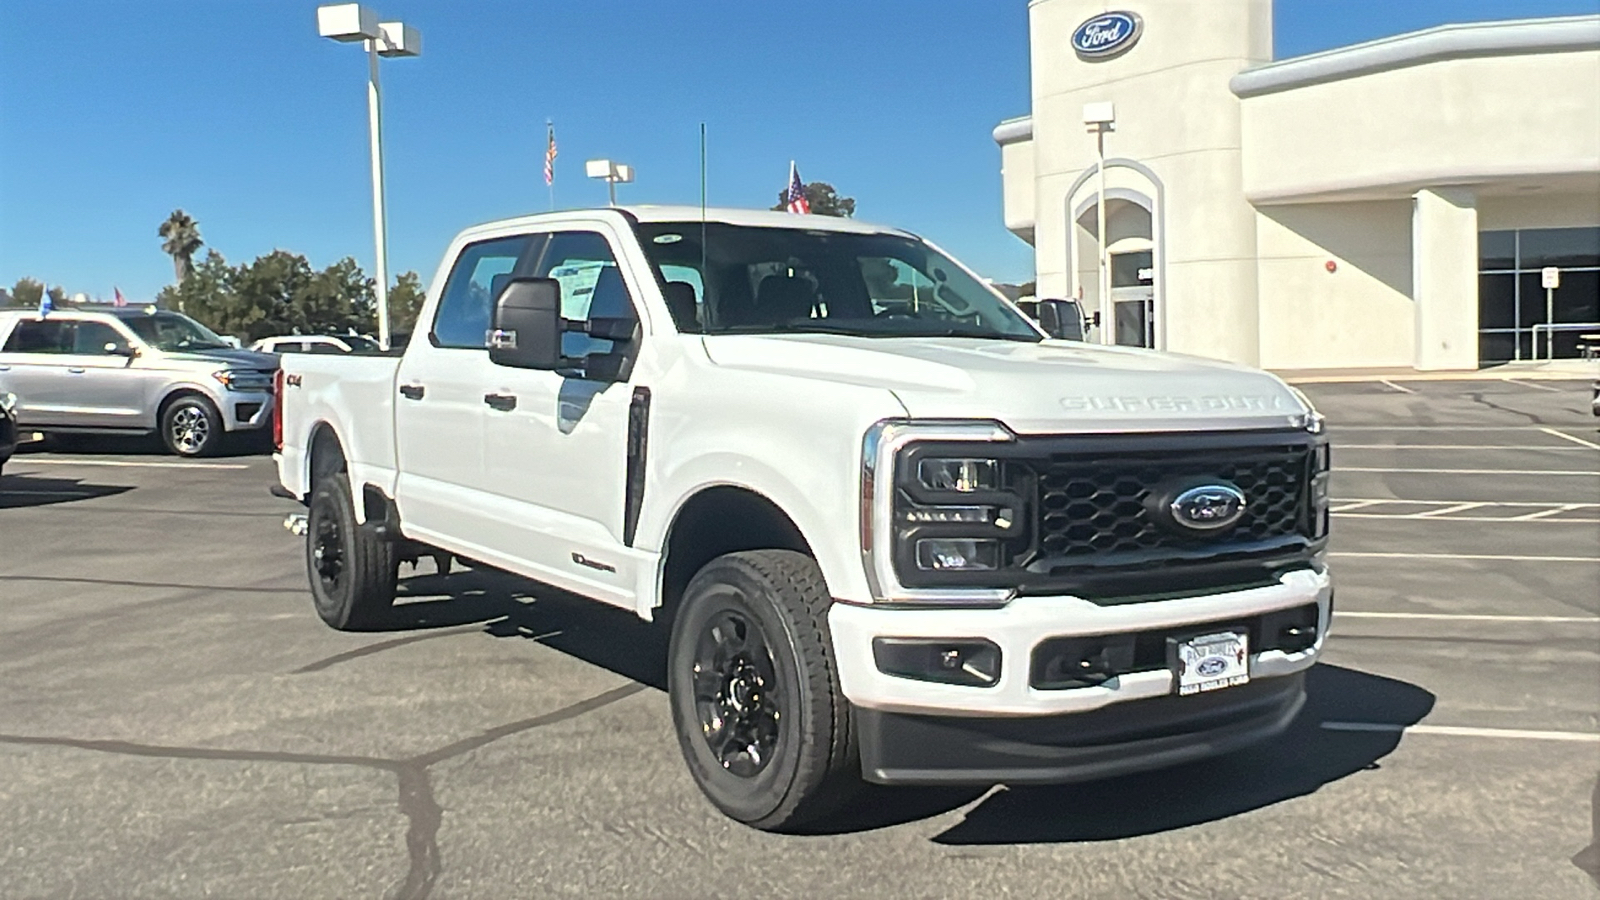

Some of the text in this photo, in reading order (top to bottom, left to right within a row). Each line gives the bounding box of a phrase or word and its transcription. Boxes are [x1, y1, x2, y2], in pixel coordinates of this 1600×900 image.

[1081, 19, 1121, 47] Ford
[1059, 394, 1282, 411] SUPER DUTY
[1189, 495, 1231, 519] Ford
